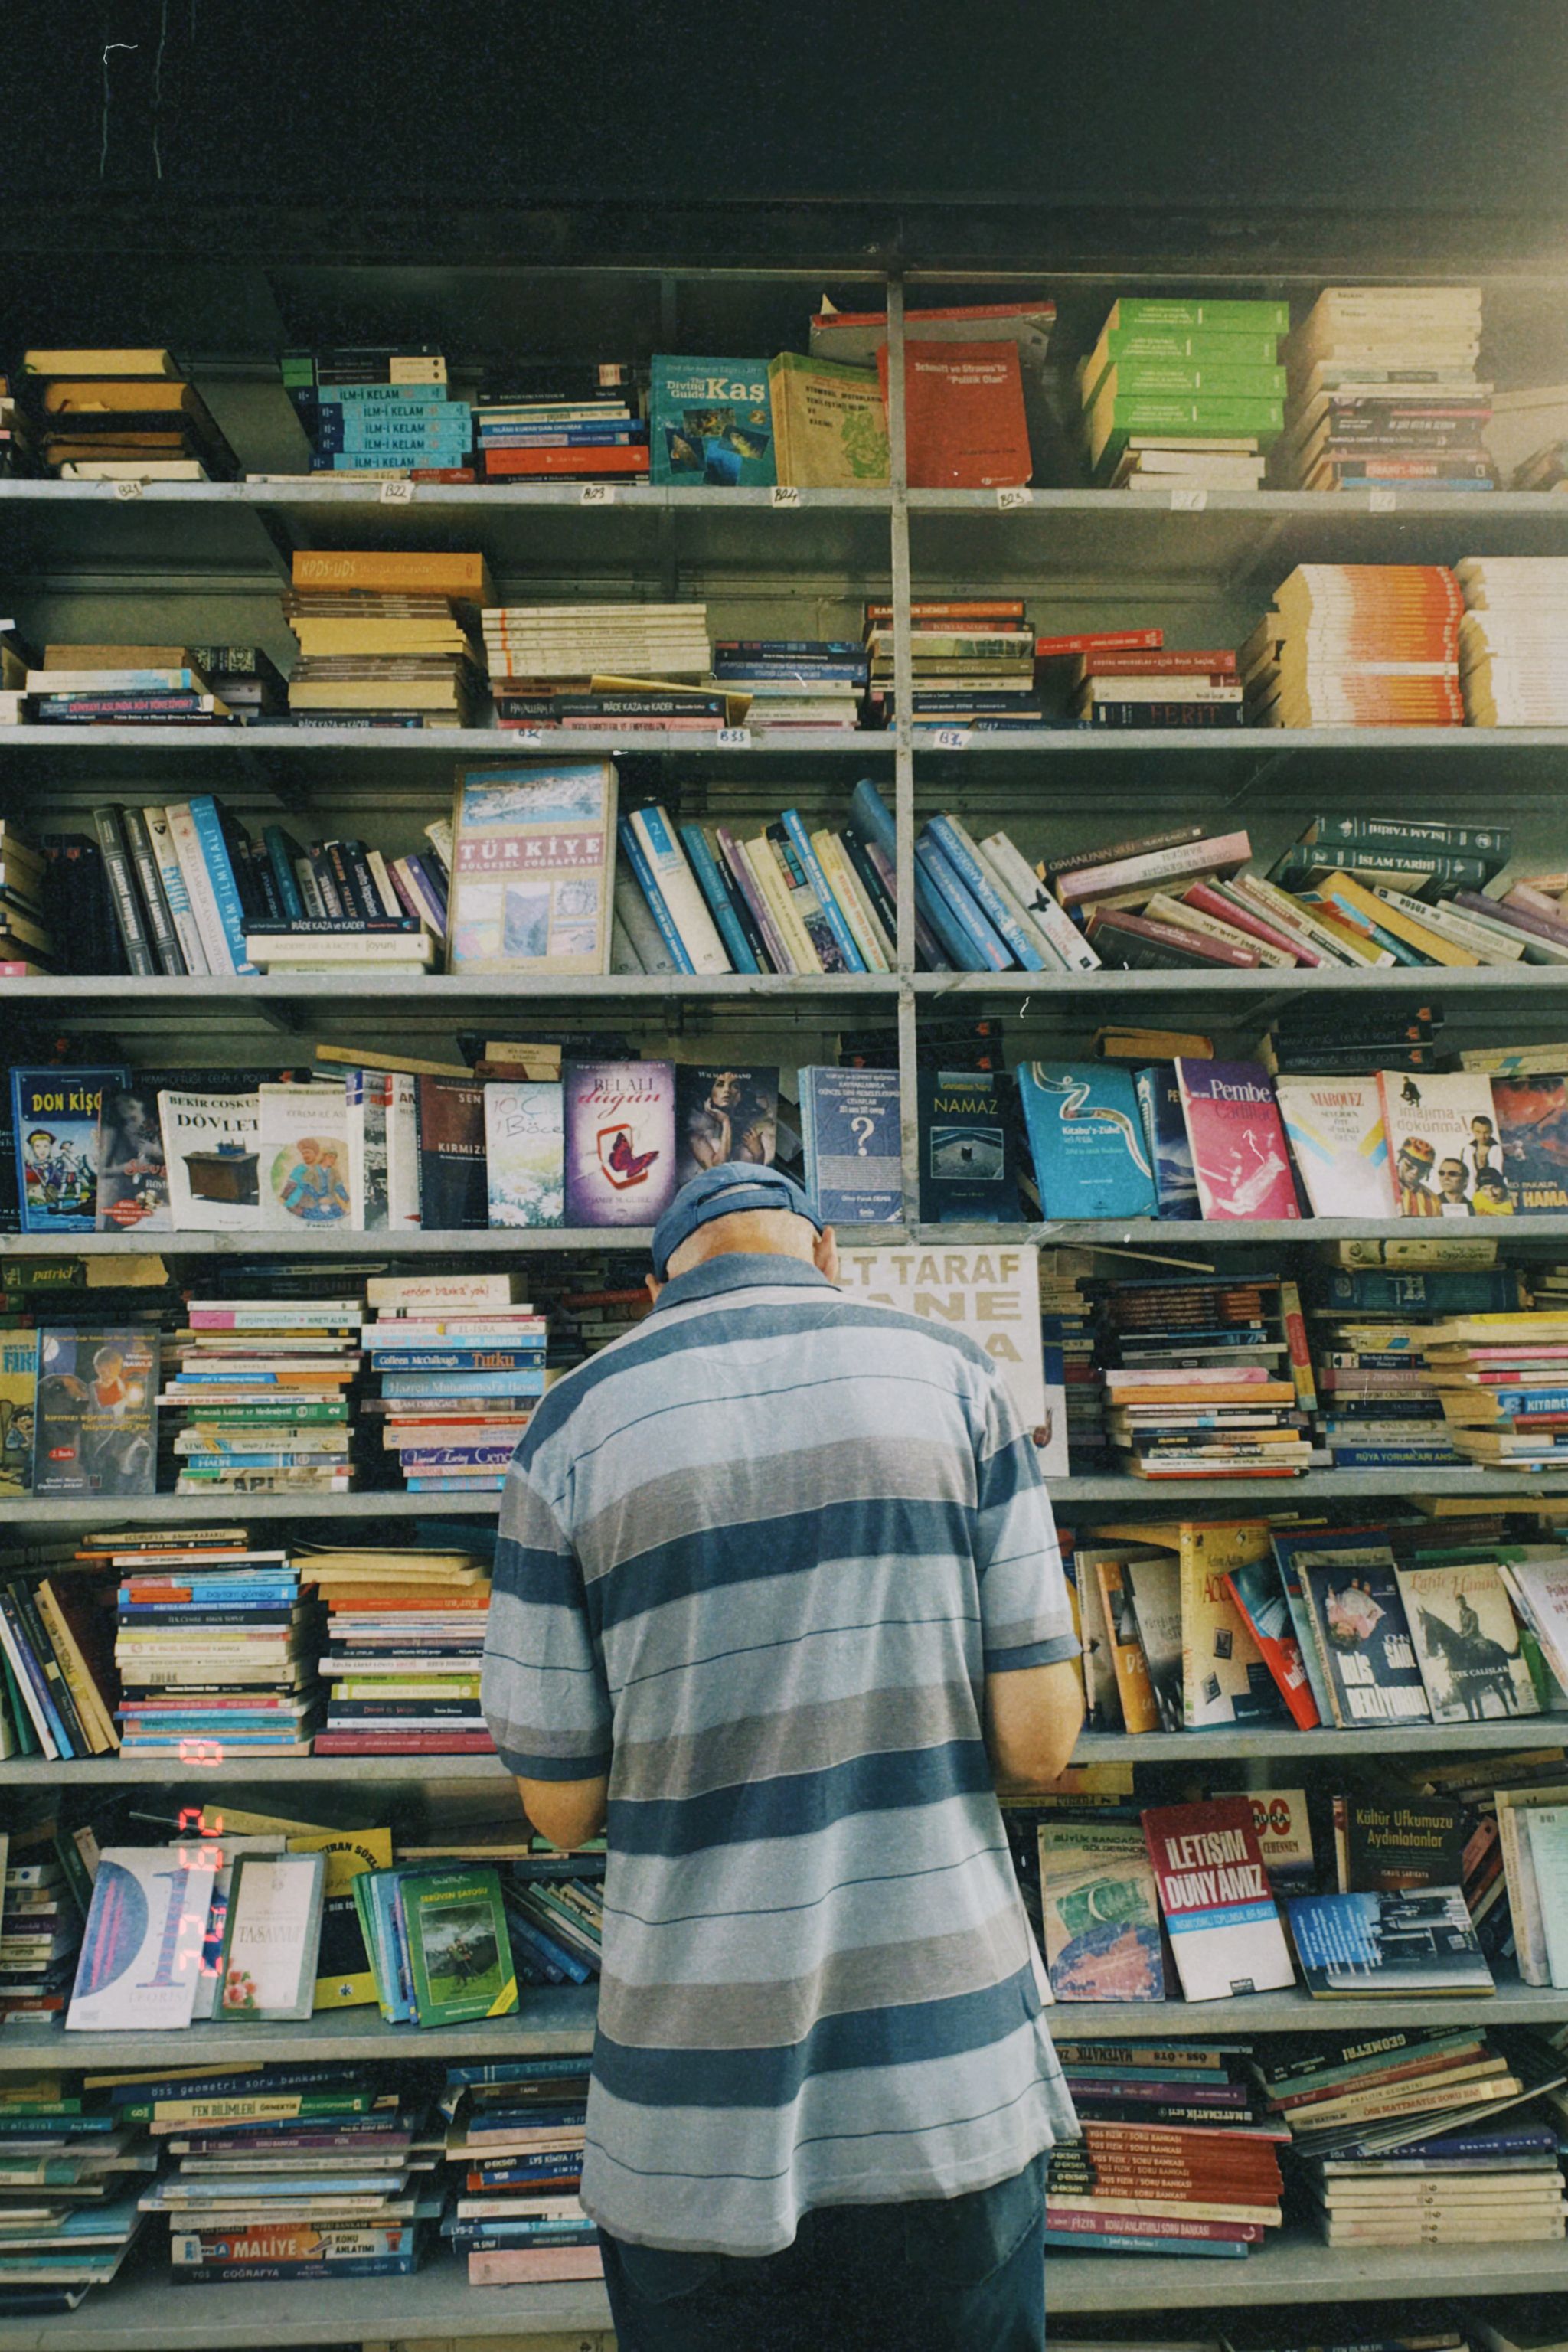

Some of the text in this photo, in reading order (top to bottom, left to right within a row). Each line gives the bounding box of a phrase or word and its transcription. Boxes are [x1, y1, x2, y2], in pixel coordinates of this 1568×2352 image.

[667, 381, 705, 391] Diving
[706, 377, 766, 403] Kaş
[340, 388, 399, 400] İLM-İ KELAM
[671, 390, 705, 399] Guide
[364, 405, 423, 416] İLM-İ KELAM
[365, 422, 425, 433] İLM-İ KELAM
[365, 438, 424, 449] İLM-İ KELAM
[355, 456, 414, 467] İLM-İ KELAM
[622, 701, 673, 712] KAZA KADER
[1150, 704, 1219, 724] FERİT
[720, 730, 744, 743] B33
[1369, 825, 1446, 841] İSLAM TARİHİ
[461, 837, 600, 859] TÜRKİYE
[461, 855, 598, 870] BÖLGESEL COĞRAFYASI
[1358, 854, 1435, 871] İSLAM TARİHİ
[207, 828, 246, 950] İSLÂM İLMİHALİ
[313, 921, 332, 930] KAZA
[342, 920, 364, 930] KADER
[594, 1077, 654, 1093] BELALI
[1210, 1079, 1273, 1103] Pembe
[31, 1094, 64, 1112] DON
[169, 1096, 208, 1108] BEKİR
[459, 1093, 482, 1103] SEN
[1310, 1092, 1364, 1107] MARQUEZ
[934, 1098, 998, 1115] NAMAZ
[438, 1143, 486, 1155] KIRMIZI
[891, 1254, 1021, 1285] TARAF
[379, 1353, 514, 1367] Colleen McCullough Tutku
[256, 1407, 292, 1416] Medeniyeti
[1356, 1451, 1432, 1461] RÜYA YORUMLARI
[1356, 1808, 1453, 1829] Kültür Ufkumuzu
[1054, 1834, 1089, 1844] BÜYÜK
[1367, 1829, 1442, 1848] Aydınlatanlar
[1165, 1829, 1249, 1871] İLETİŞİM
[1164, 1864, 1268, 1909] DÜNYAMIZ
[457, 1887, 488, 1900] ŞATOSU
[1342, 2034, 1406, 2061] GEOMETRİ
[1076, 2047, 1133, 2062] MATEMATİK
[181, 2073, 329, 2096] geometri soru bankası
[192, 2101, 256, 2116] FEN BİLİMLERİ
[1187, 2109, 1243, 2120] MATEMATİK
[1108, 2131, 1122, 2139] FİZİK
[1129, 2132, 1148, 2141] SORU
[1152, 2135, 1181, 2143] BANKASI
[1130, 2144, 1148, 2152] SORU
[1151, 2146, 1182, 2154] BANKASI
[529, 2154, 568, 2166] LYS KİMYA
[1132, 2156, 1152, 2165] SORU
[1154, 2158, 1184, 2167] BANKASI
[1158, 2168, 1190, 2177] BANKASI
[1119, 2177, 1133, 2185] FİZİK
[1140, 2177, 1159, 2186] SORU
[1161, 2180, 1192, 2188] BANKASI
[1155, 2191, 1187, 2200] BANKASI
[1071, 2218, 1096, 2230] FİZİK
[1161, 2223, 1179, 2234] SORU
[1181, 2225, 1210, 2236] BANKASI
[335, 2235, 359, 2243] KONU
[233, 2237, 296, 2257] MALİYE
[335, 2244, 374, 2254] ANLATIMI
[222, 2267, 279, 2279] COĞRAFYA
